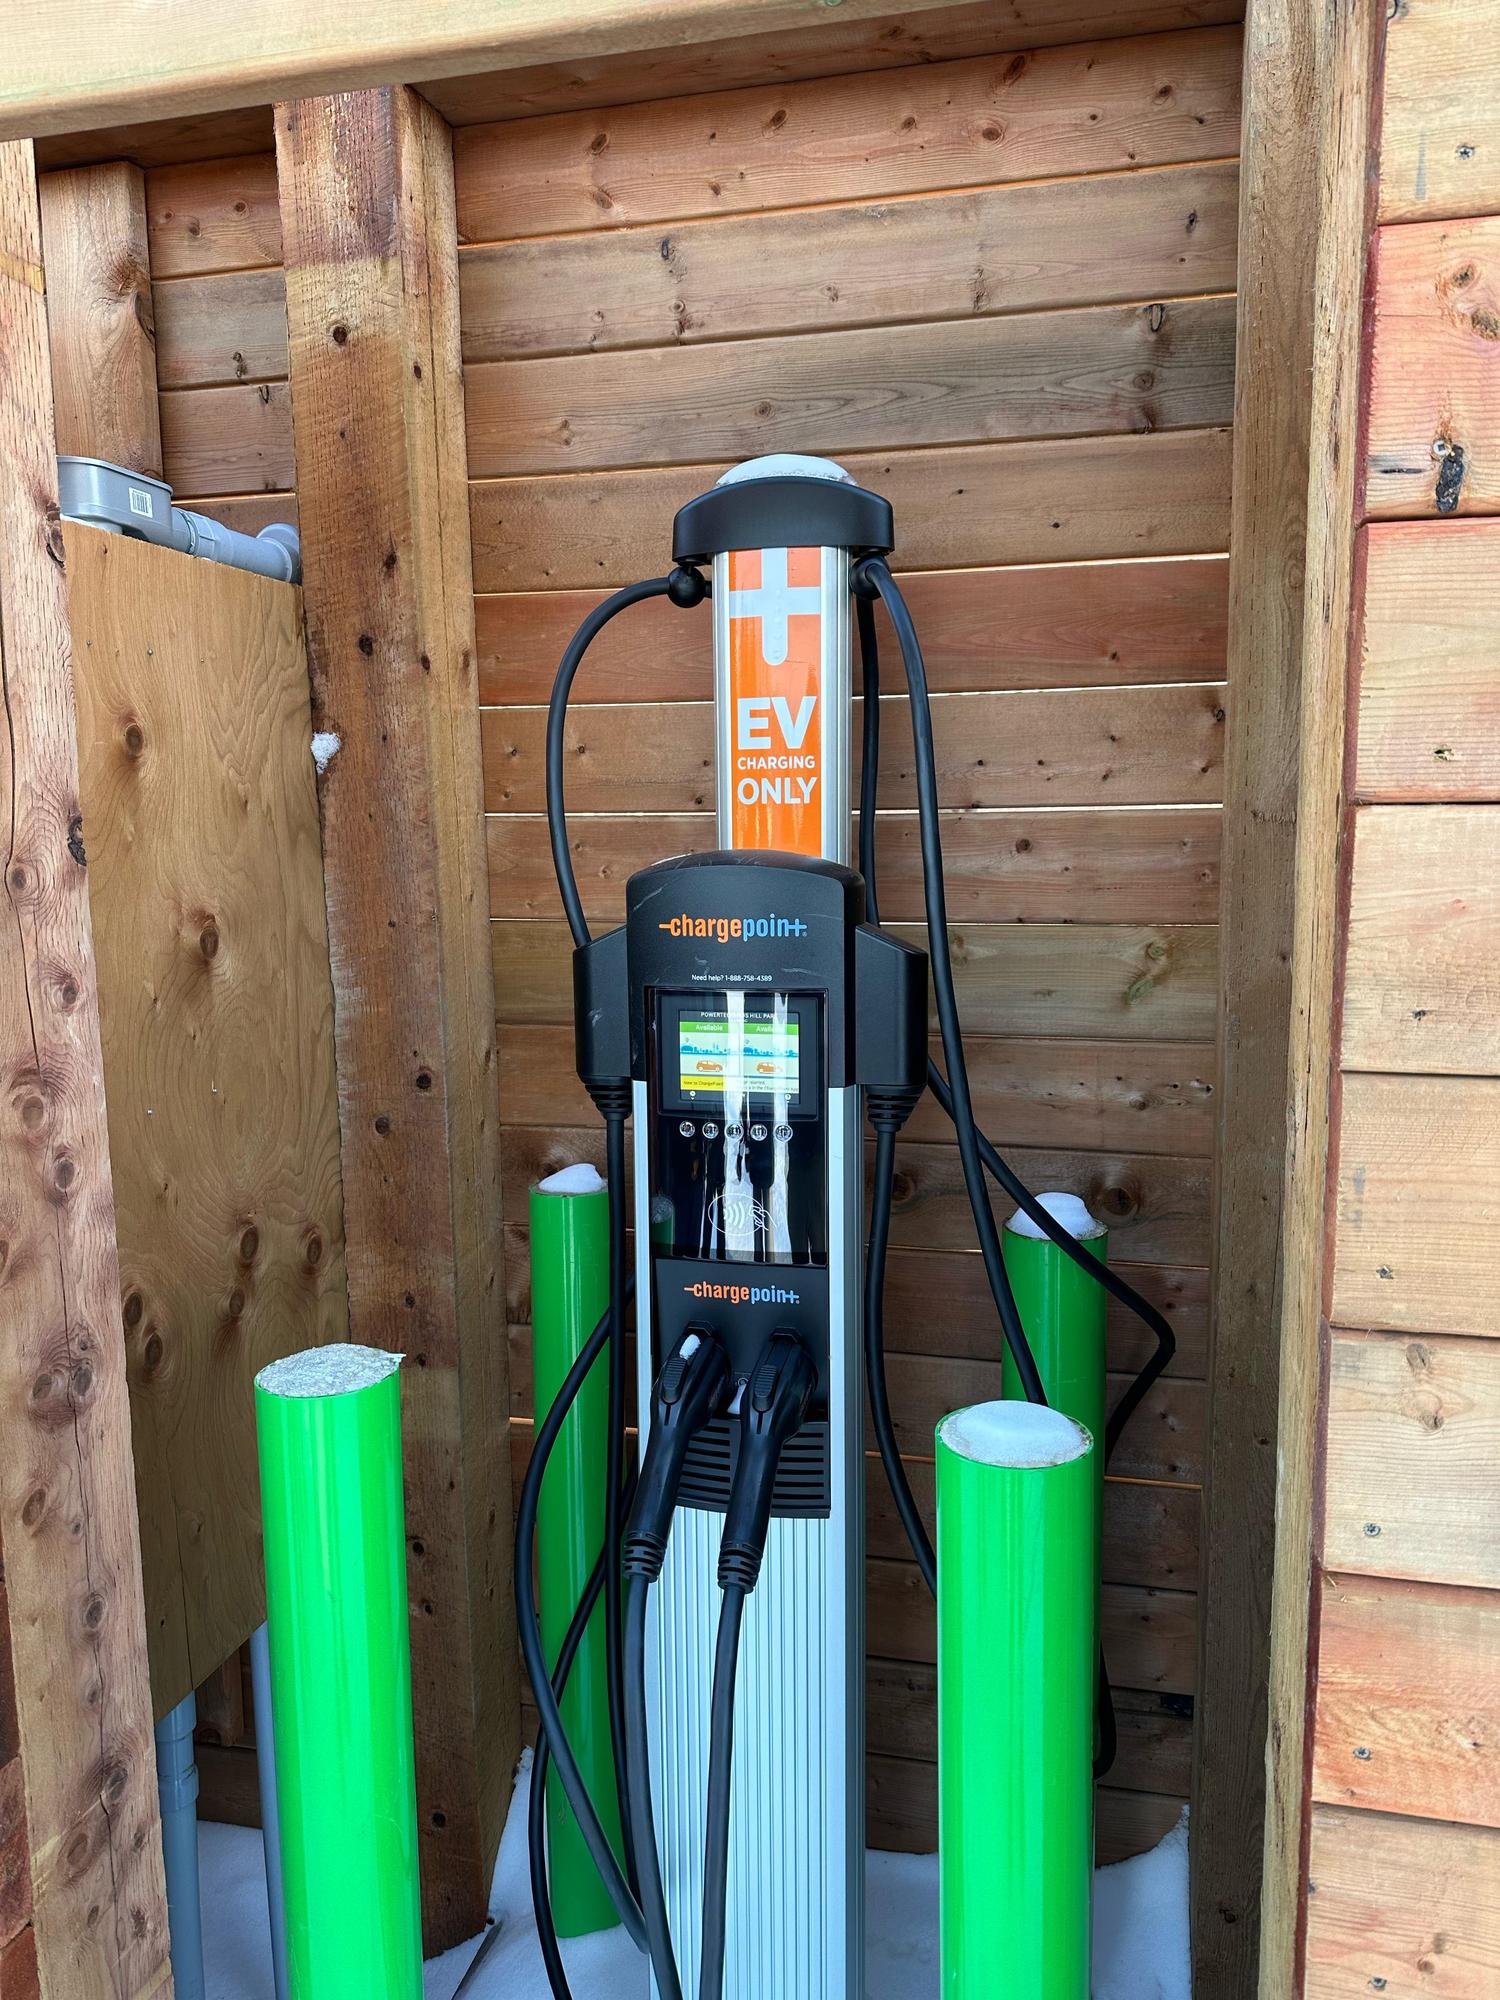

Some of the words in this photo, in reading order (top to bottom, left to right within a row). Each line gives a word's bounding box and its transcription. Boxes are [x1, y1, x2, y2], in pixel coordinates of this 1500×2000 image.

[737, 696, 817, 750] EV
[737, 756, 815, 769] CHARGING
[737, 777, 817, 805] ONLY
[708, 974, 724, 982] help?
